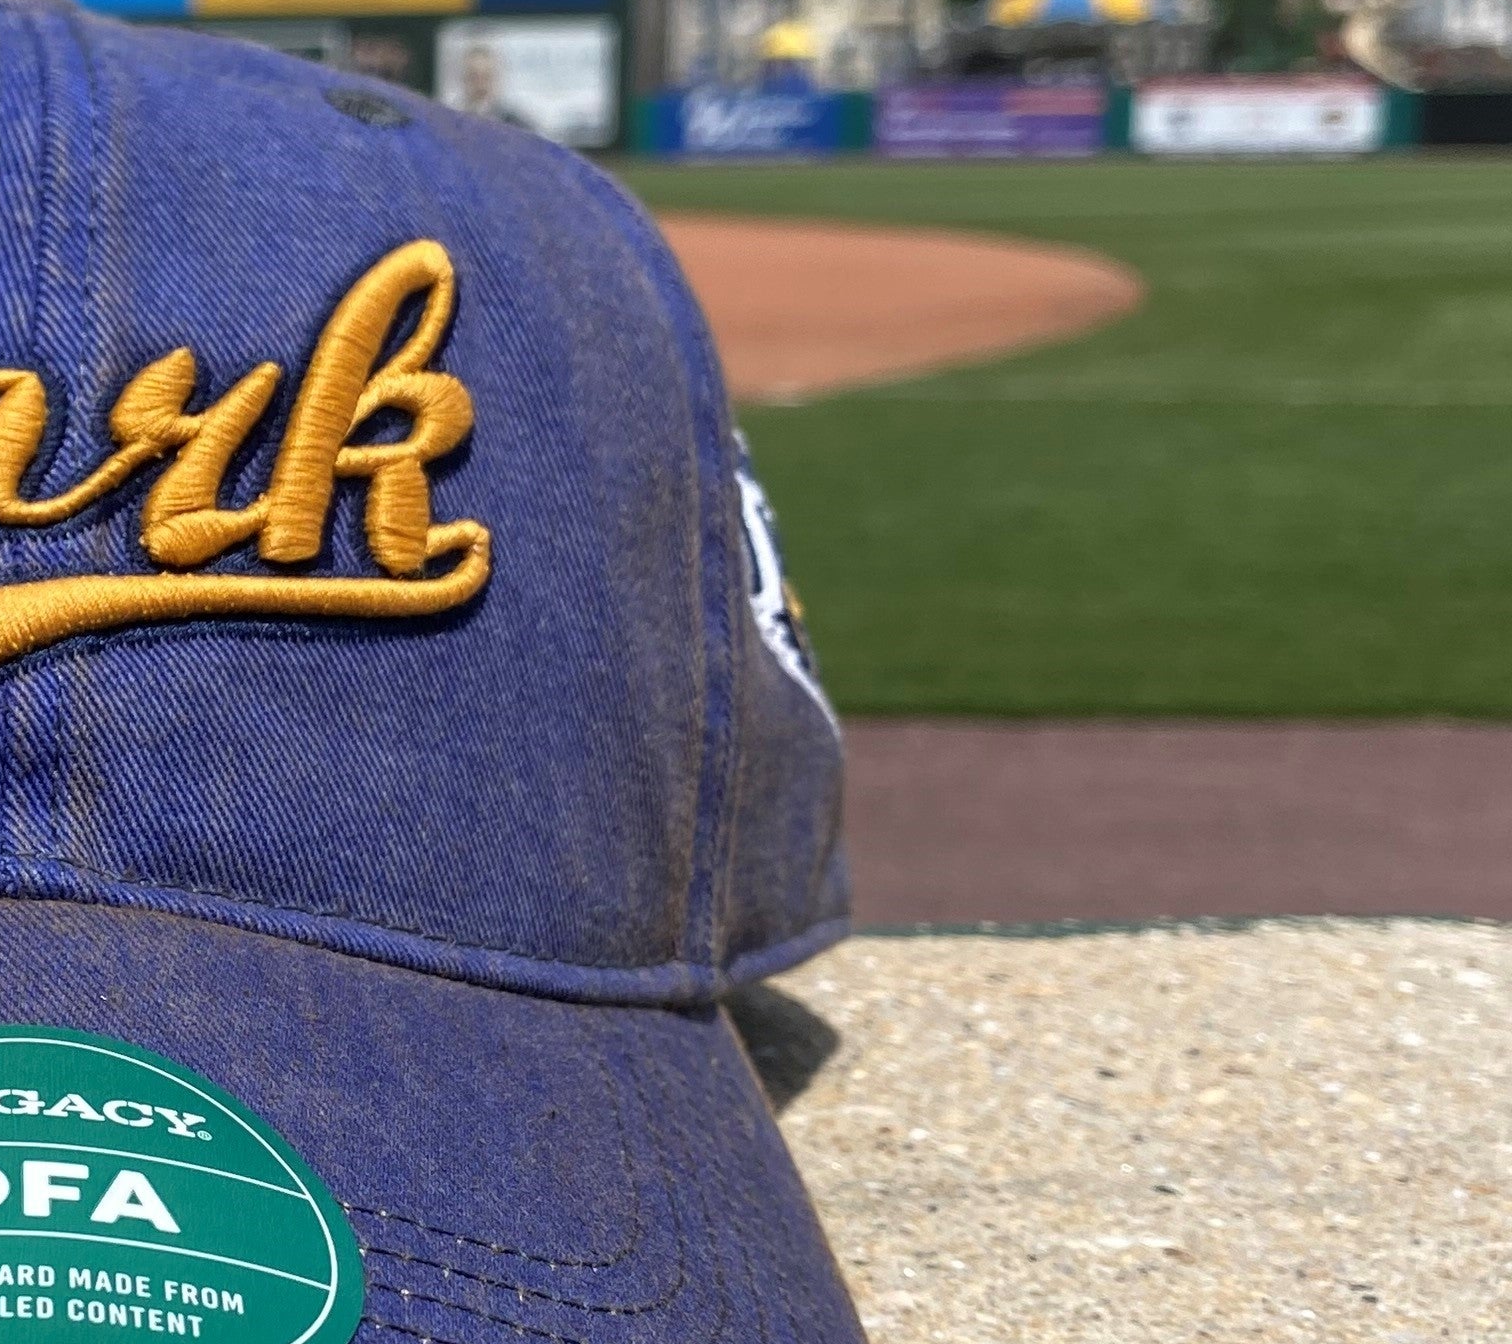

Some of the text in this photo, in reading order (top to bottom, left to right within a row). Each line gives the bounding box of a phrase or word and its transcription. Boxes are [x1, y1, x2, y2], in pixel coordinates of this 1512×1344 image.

[68, 1267, 151, 1298] MADE
[164, 1280, 244, 1315] FROM
[67, 1298, 203, 1338] CONTENT
